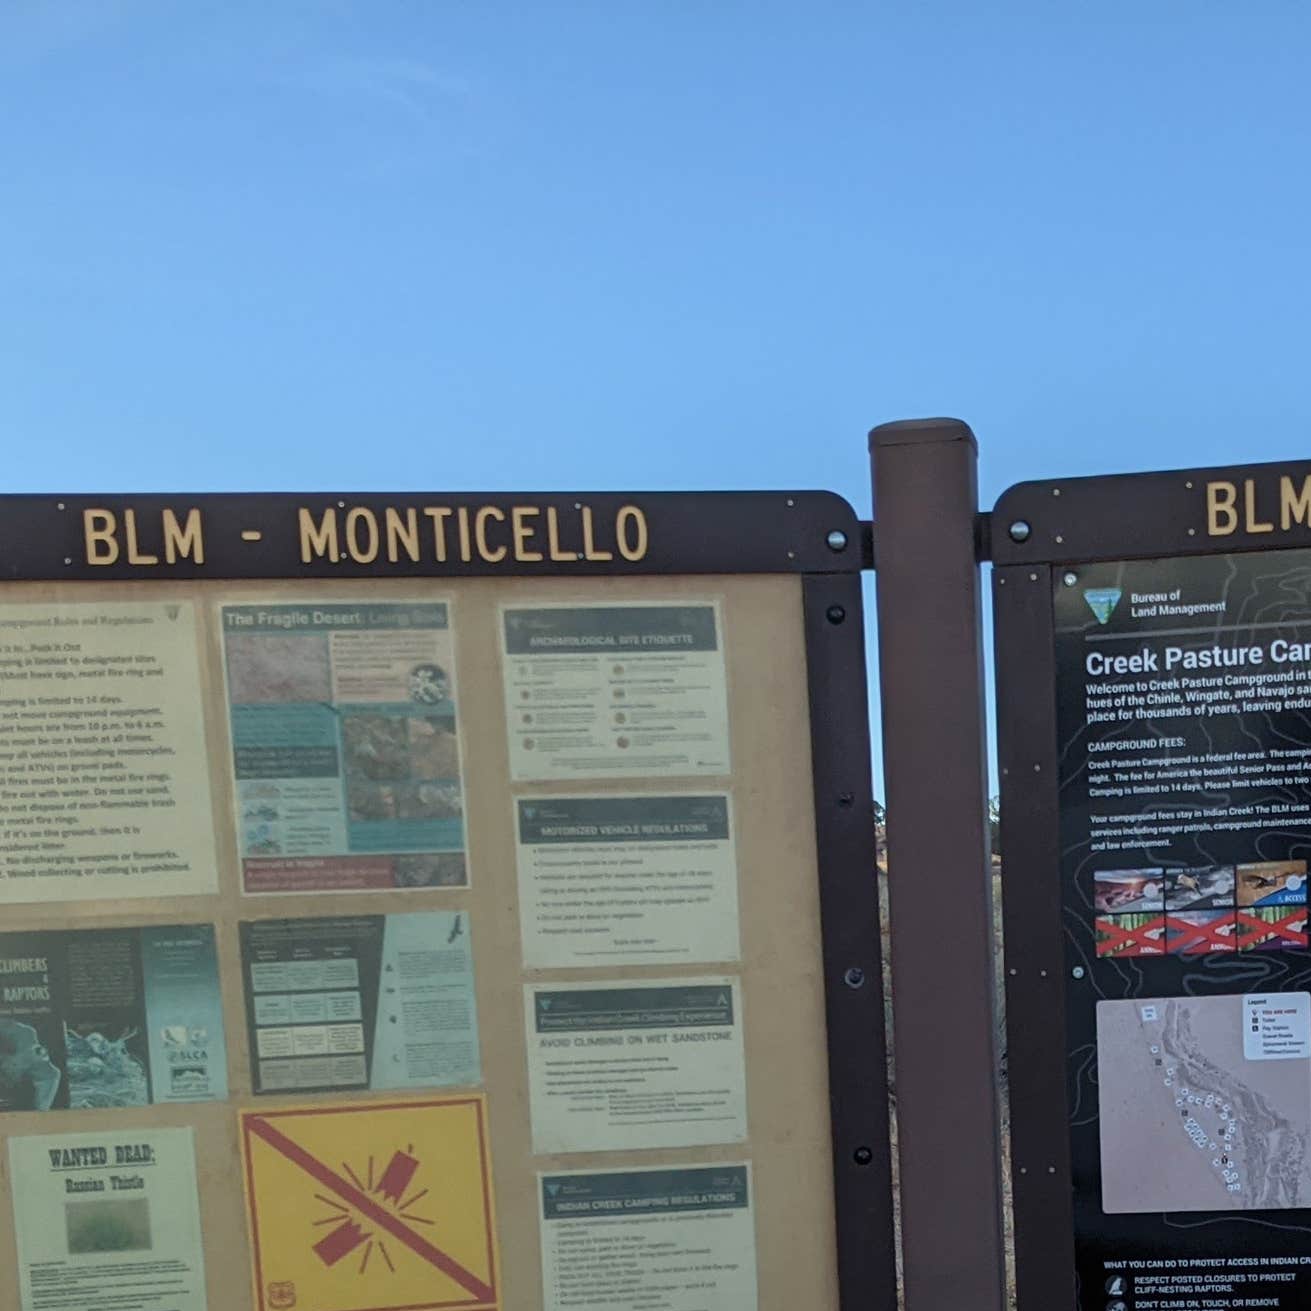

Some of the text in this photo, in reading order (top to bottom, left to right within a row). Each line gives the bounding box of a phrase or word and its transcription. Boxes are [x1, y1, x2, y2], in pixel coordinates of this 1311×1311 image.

[84, 507, 205, 565] BLM
[299, 505, 648, 564] MONTICELLO
[1130, 590, 1180, 603] Bureau of
[1131, 601, 1226, 617] Land Management
[227, 611, 360, 627] The Fragile Desert
[1086, 647, 1156, 675] Creek
[1165, 643, 1262, 669] Pasture
[1086, 682, 1134, 695] Welcome
[1136, 680, 1147, 691] to
[1149, 677, 1179, 690] Creek
[1181, 676, 1223, 688] Pasture
[1224, 670, 1294, 687] Campground
[1295, 670, 1306, 681] in
[1086, 696, 1112, 708] hues
[1114, 694, 1125, 706] of
[1127, 693, 1145, 705] the
[1146, 691, 1184, 704] Chinle,
[1185, 688, 1233, 703] Wingate,
[1234, 686, 1255, 698] and
[1256, 685, 1294, 698] Navajo
[1086, 710, 1115, 725] place
[1118, 708, 1132, 720] for
[1135, 704, 1191, 719] thousands
[1194, 703, 1206, 715] of
[1208, 703, 1240, 717] years,
[1242, 699, 1282, 713] leaving
[1087, 738, 1185, 752] CAMPGROUND FEES:
[49, 1144, 154, 1167] WANTED DEAD:
[65, 1174, 144, 1193] Russian Thistle
[1103, 1261, 1126, 1269] WHAT
[1129, 1260, 1145, 1268] YOU
[1146, 1260, 1163, 1268] CAN
[1164, 1260, 1176, 1268] DO
[1178, 1259, 1188, 1267] TO
[1189, 1259, 1225, 1267] PROTECT
[1227, 1258, 1258, 1266] ACCESS
[1260, 1258, 1269, 1266] IN
[1270, 1257, 1298, 1265] INDIAN
[1134, 1273, 1295, 1284] RESPECT POSTED CLOSURES TO PROTECT
[1134, 1284, 1234, 1294] CLIFF-NESTING RAPTORS.
